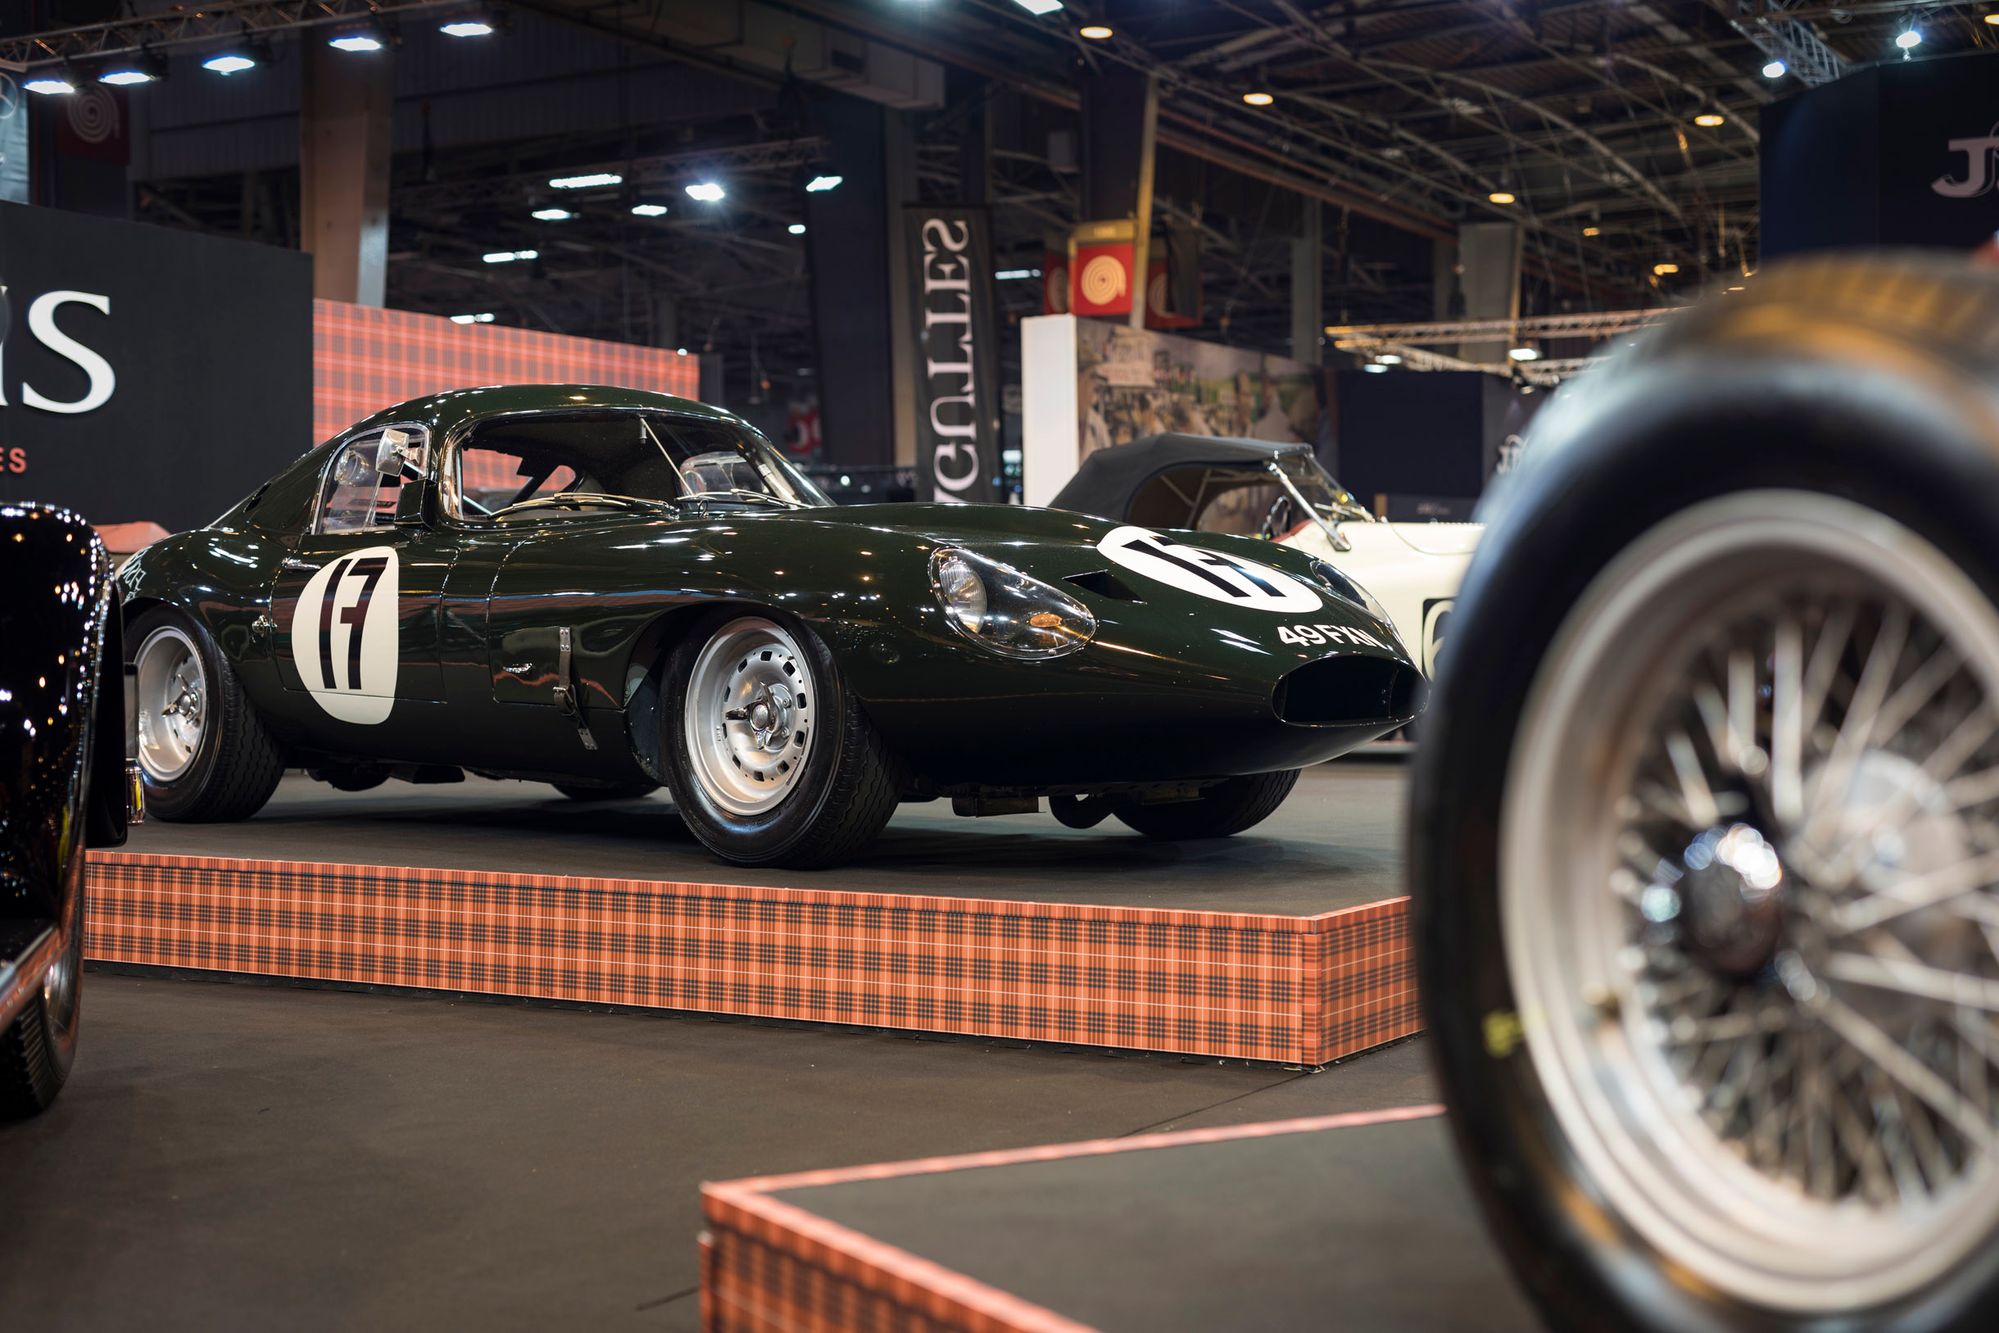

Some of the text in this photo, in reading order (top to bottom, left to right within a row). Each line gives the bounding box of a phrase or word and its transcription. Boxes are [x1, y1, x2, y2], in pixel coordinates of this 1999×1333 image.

[0, 286, 115, 413] S
[319, 557, 389, 690] 17
[1121, 536, 1287, 598] 17
